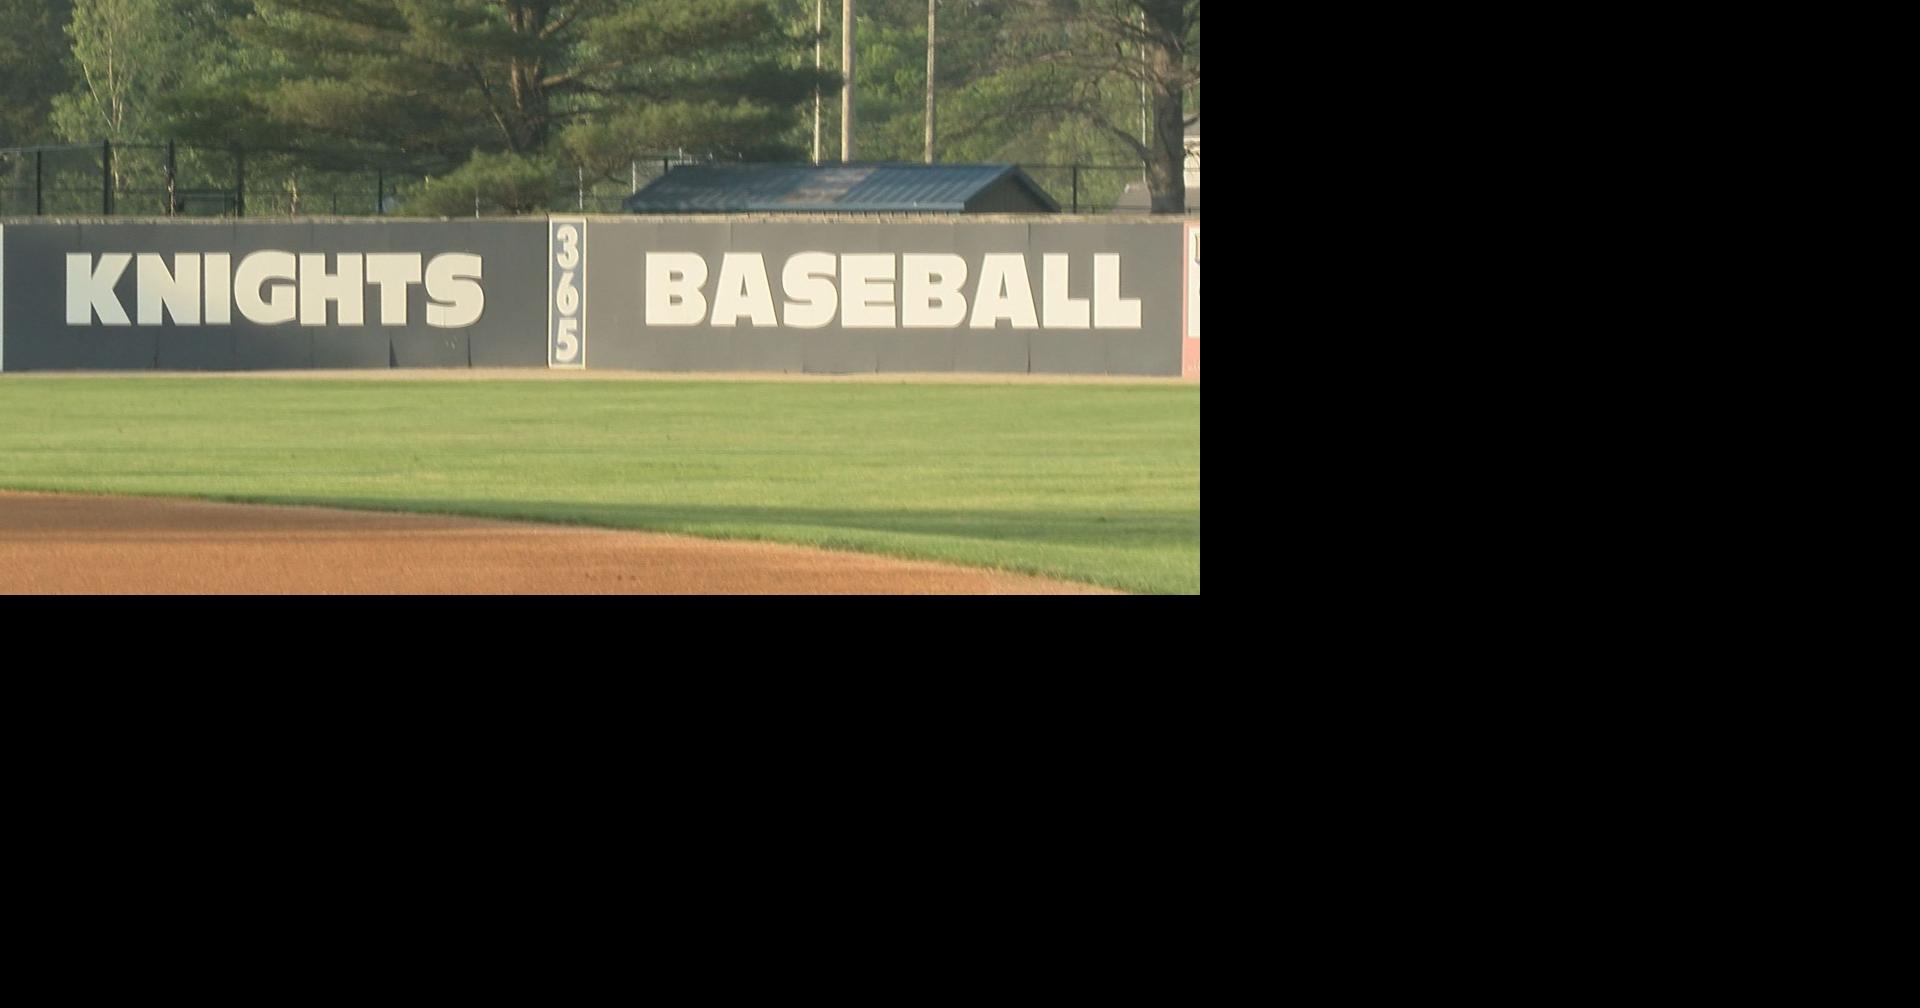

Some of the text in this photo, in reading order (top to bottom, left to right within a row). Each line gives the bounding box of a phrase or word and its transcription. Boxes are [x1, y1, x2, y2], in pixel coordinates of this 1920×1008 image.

[65, 250, 485, 328] KNIGHTS
[556, 224, 579, 362] 365
[645, 251, 1142, 328] BASEBALL
